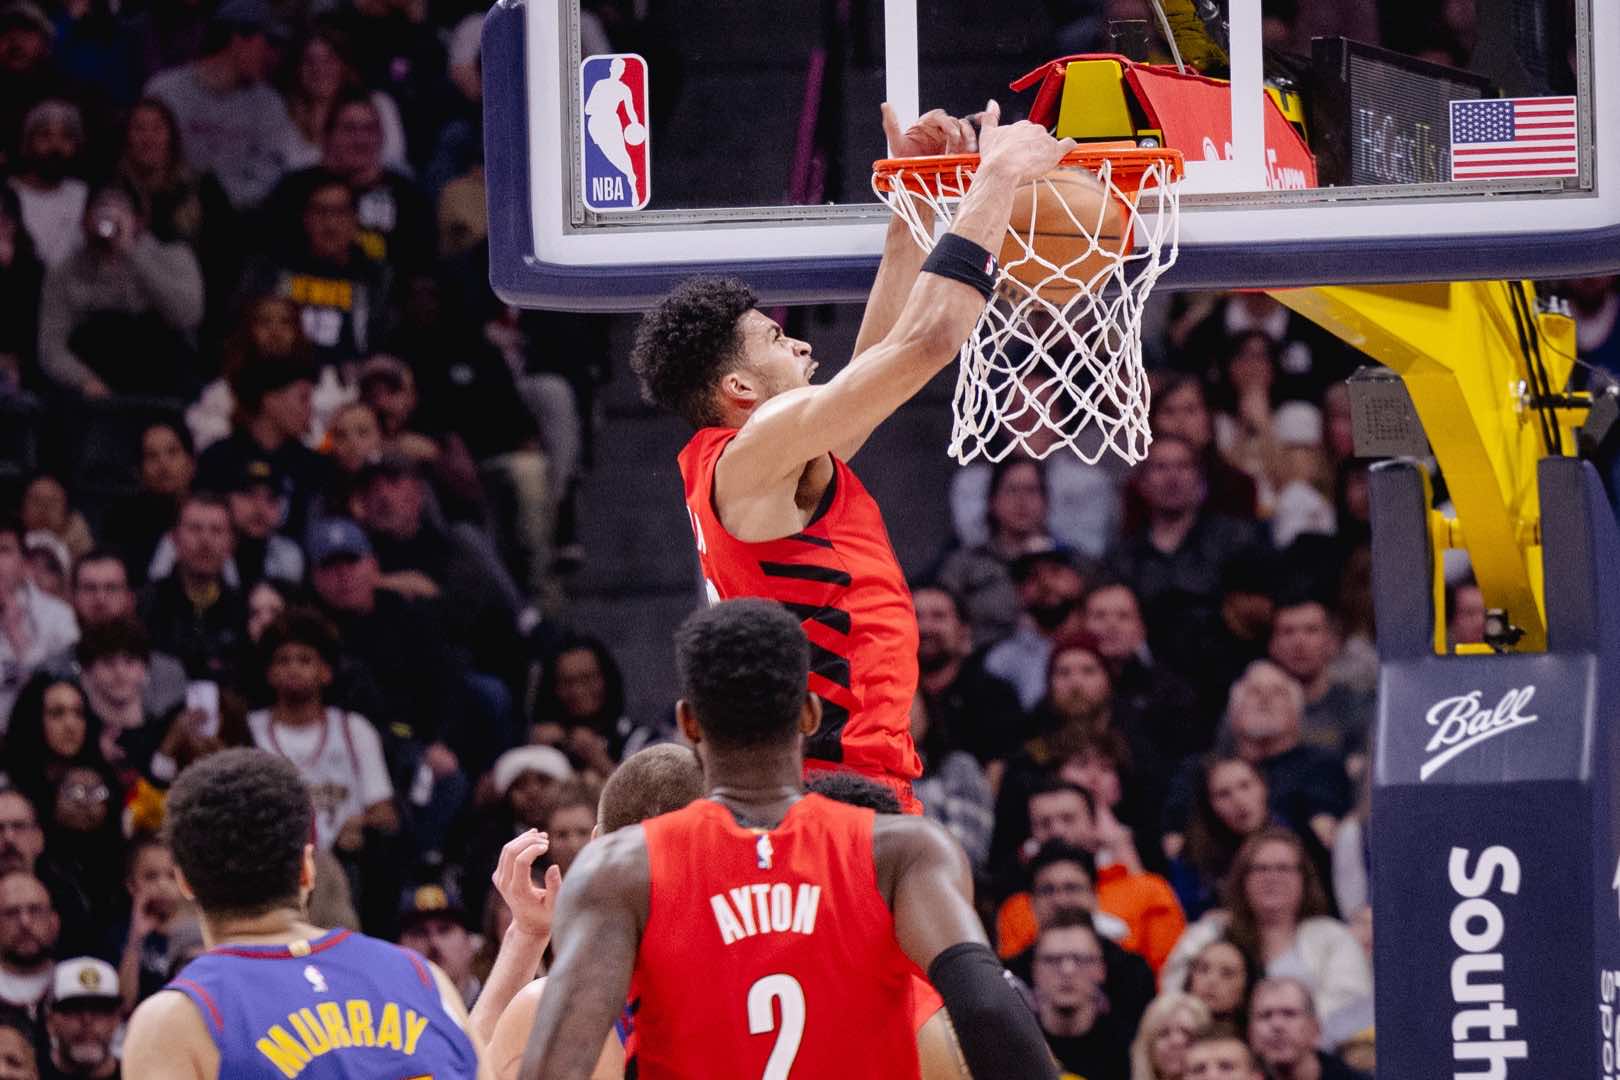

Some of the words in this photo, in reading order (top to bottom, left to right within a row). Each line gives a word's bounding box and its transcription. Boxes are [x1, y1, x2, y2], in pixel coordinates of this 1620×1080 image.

[592, 176, 624, 202] NBA
[1420, 685, 1539, 781] Ball
[709, 884, 822, 946] AYTON
[255, 999, 429, 1080] MURRAY
[746, 973, 807, 1080] 2
